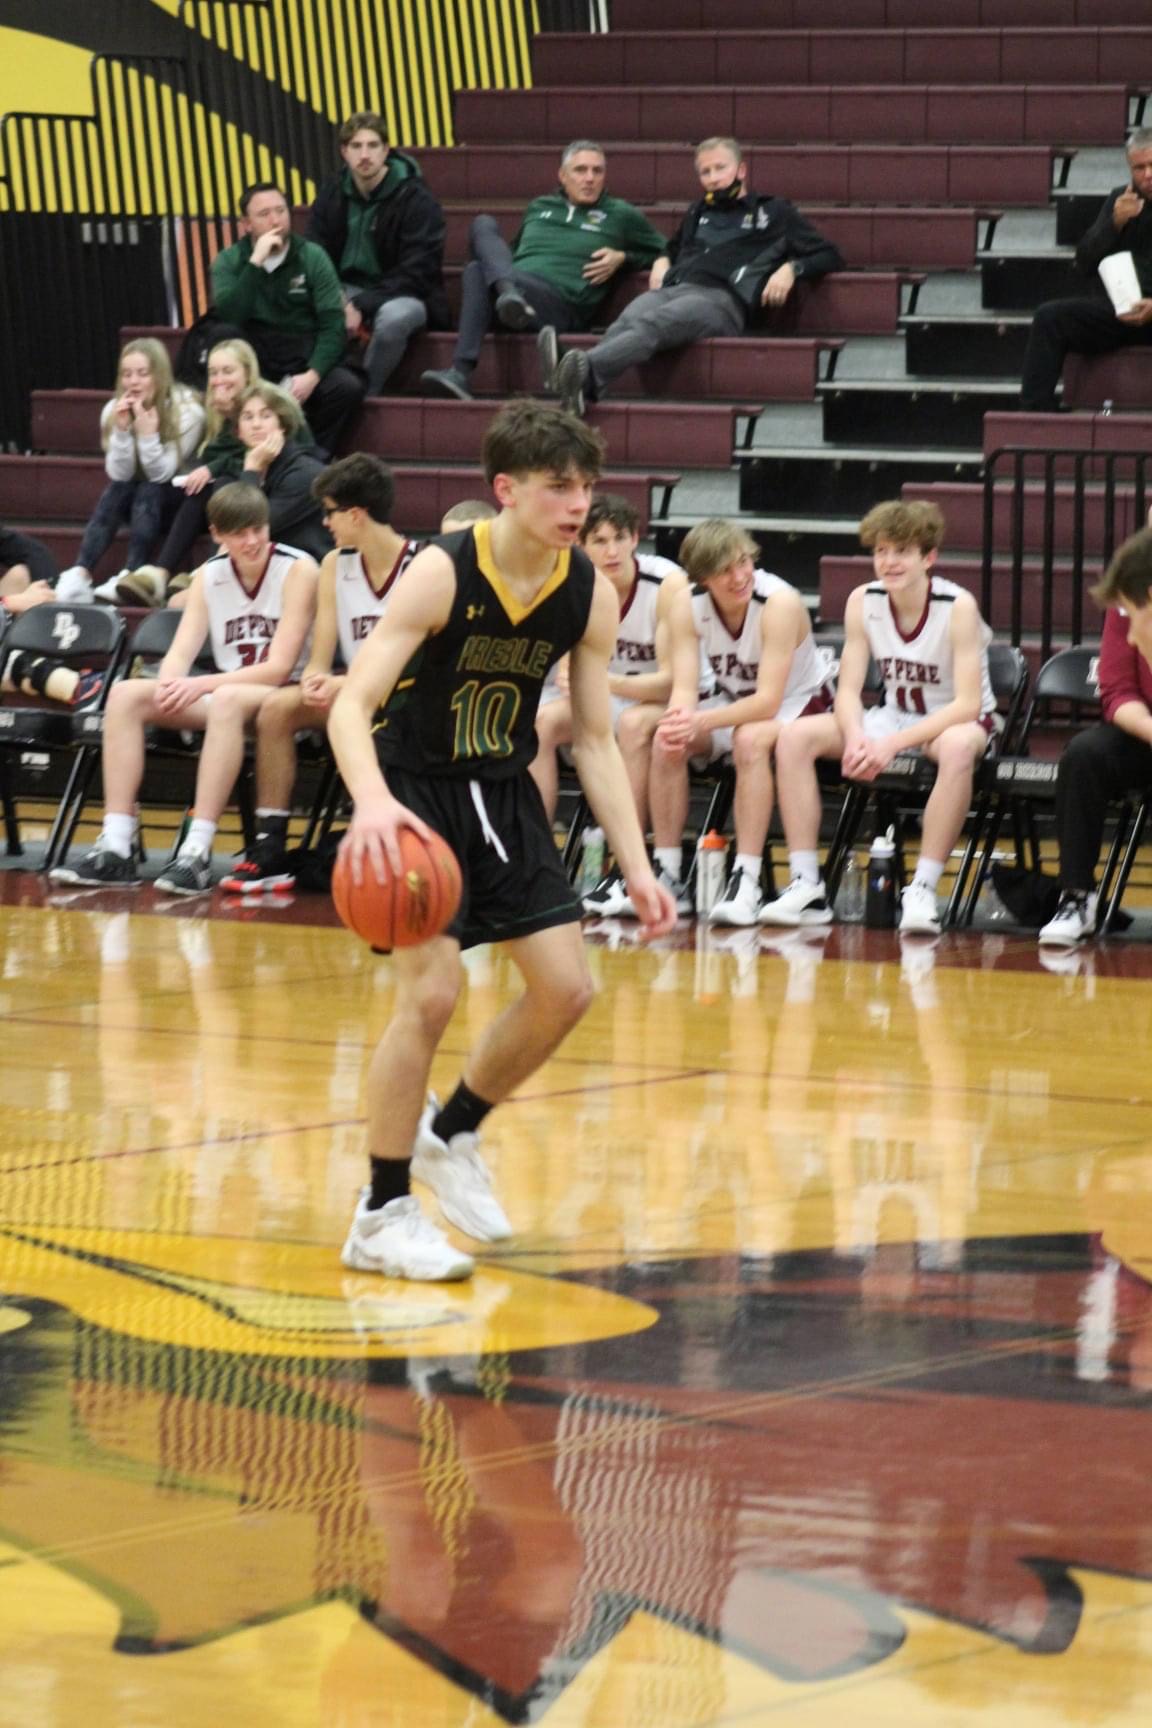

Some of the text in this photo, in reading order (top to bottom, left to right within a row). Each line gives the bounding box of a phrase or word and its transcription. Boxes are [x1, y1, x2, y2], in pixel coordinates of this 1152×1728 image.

[895, 658, 942, 685] PERE
[896, 685, 927, 717] 11
[450, 679, 521, 761] 10
